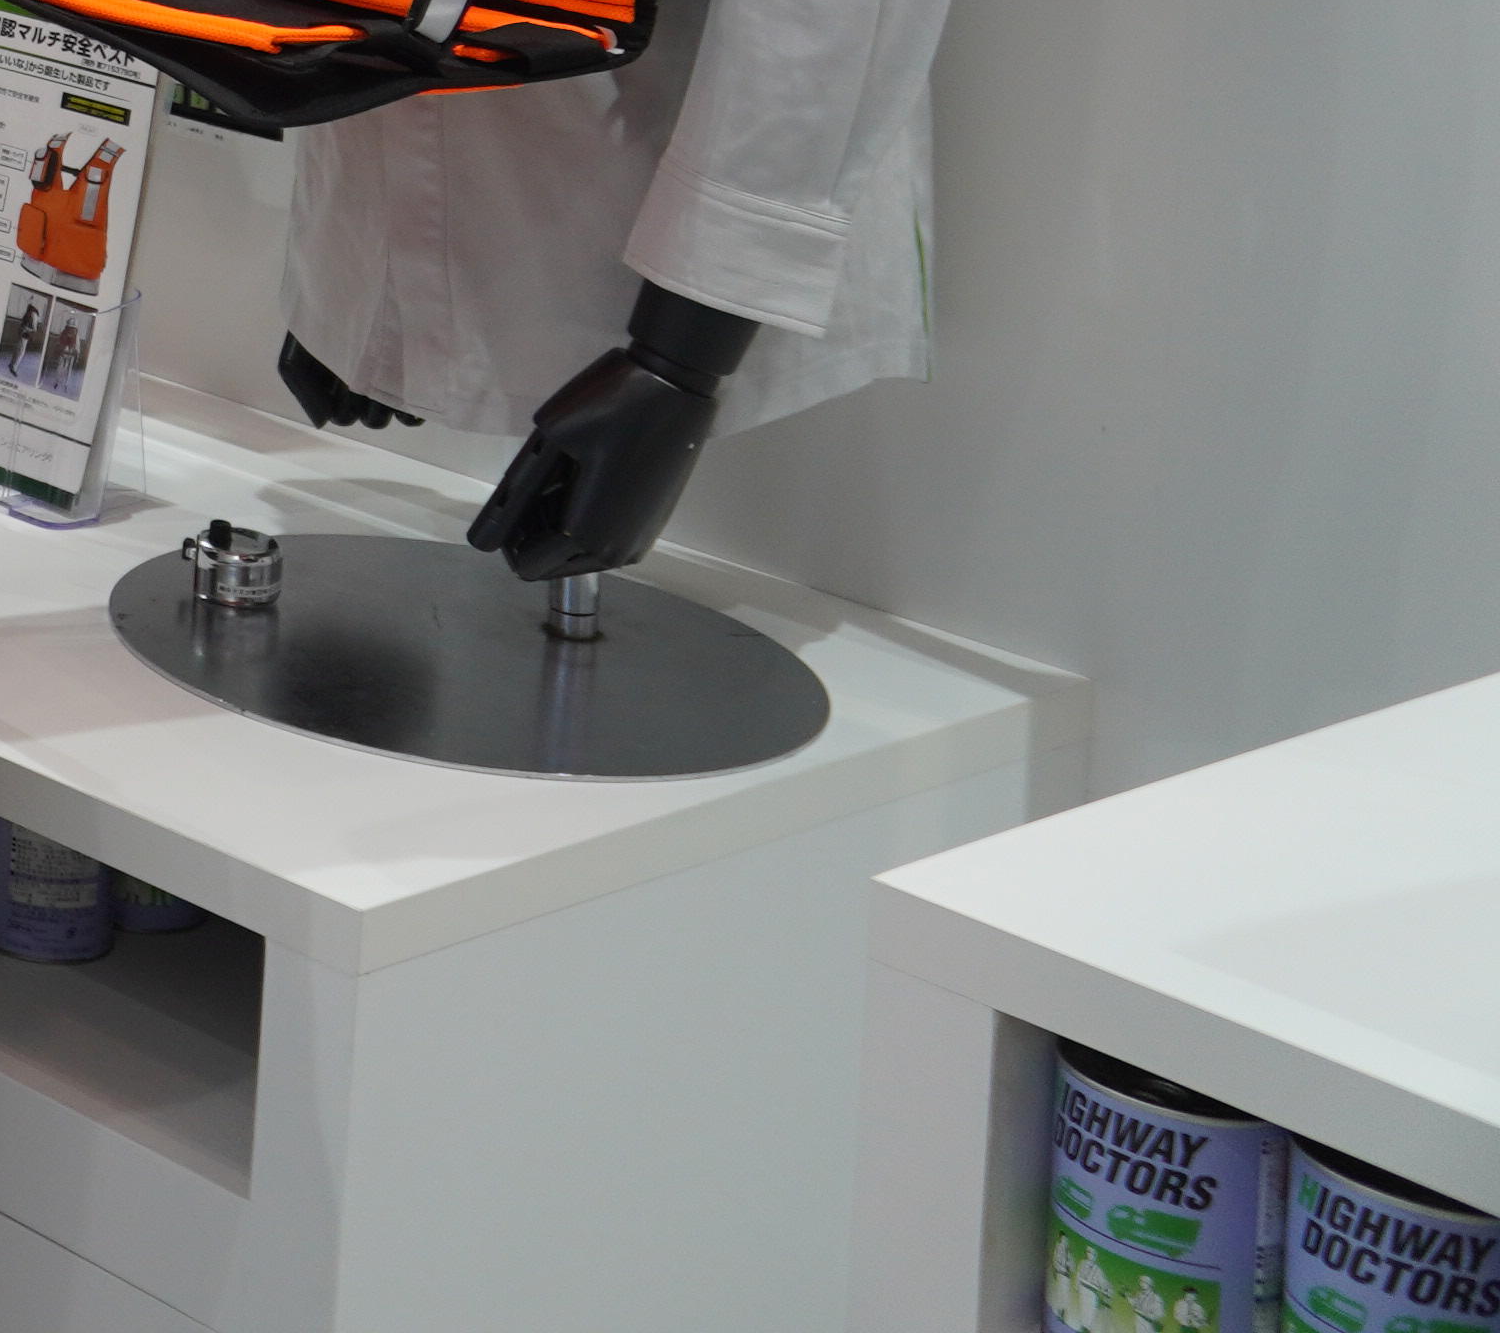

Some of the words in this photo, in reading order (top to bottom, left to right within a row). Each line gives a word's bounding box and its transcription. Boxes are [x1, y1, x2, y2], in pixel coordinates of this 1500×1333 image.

[1052, 1115, 1218, 1211] DOCTORS
[1297, 1172, 1499, 1275] HIGHWAY
[1301, 1217, 1500, 1318] DOCTORS
